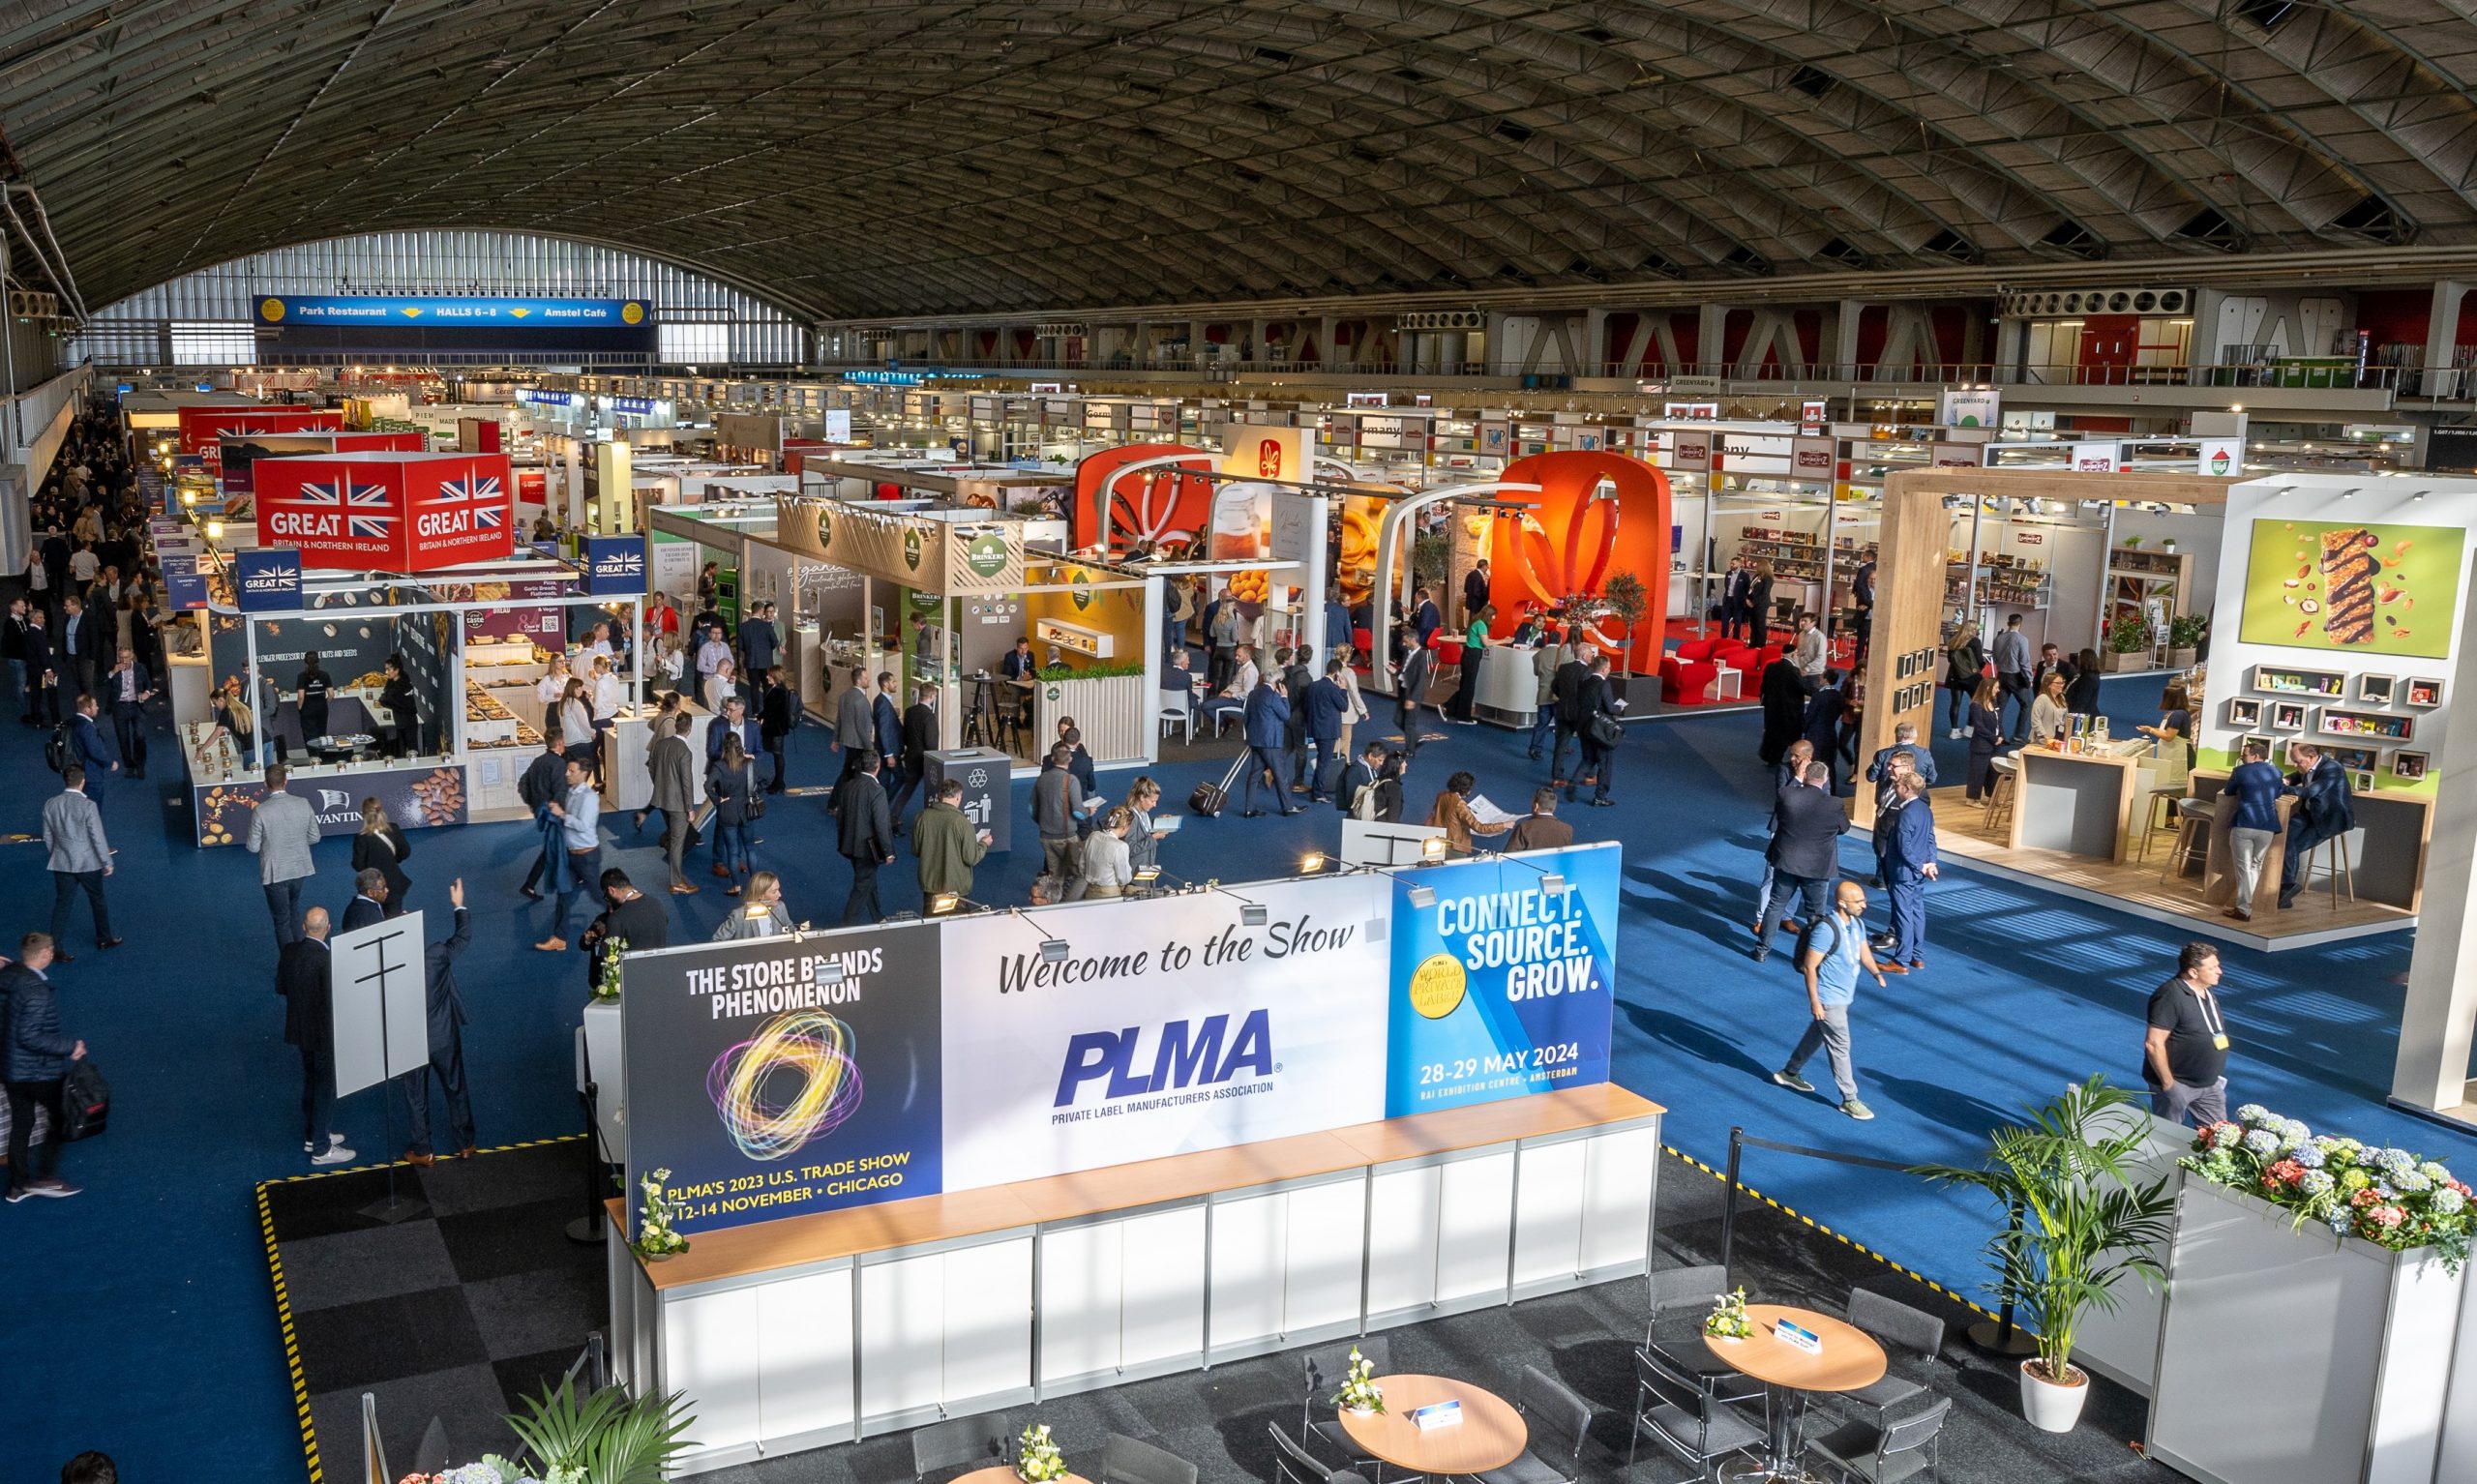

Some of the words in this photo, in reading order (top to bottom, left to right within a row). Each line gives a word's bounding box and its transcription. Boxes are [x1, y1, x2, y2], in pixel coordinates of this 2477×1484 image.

[299, 306, 324, 315] Park
[327, 306, 387, 316] Restaurant
[436, 308, 471, 317] HALLS
[544, 308, 581, 317] Amstel
[582, 308, 607, 317] Café
[1486, 429, 1505, 442] TOP
[1680, 447, 1704, 458] LAMBERTZ
[1800, 454, 1828, 465] LAMBERTZ
[2080, 461, 2108, 472] LAMBERTZ
[270, 512, 341, 537] GREAT
[417, 509, 469, 537] GREAT
[273, 539, 302, 549] BRITAIN
[303, 540, 310, 549] &
[311, 541, 353, 550] NORTHERN
[355, 543, 390, 552] IRELAND
[419, 540, 441, 551] BRITAIN
[442, 540, 447, 549] &
[447, 536, 478, 548] NORTHERN
[479, 531, 502, 543] IRELAND
[245, 579, 277, 588] GREAT
[343, 648, 358, 657] SEEDS
[1437, 883, 1583, 936] CONNECT.
[1000, 950, 1148, 994] Welcome
[1161, 939, 1191, 972] to
[1203, 923, 1253, 965] the
[1263, 914, 1355, 960] Show
[1466, 920, 1589, 971] SOURCE.
[686, 966, 727, 995] THE
[731, 959, 794, 991] STORE
[801, 947, 883, 982] BNDS
[1419, 965, 1462, 981] WORLD
[1507, 955, 1598, 1002] GROW.
[1415, 977, 1463, 994] PRIVATE
[712, 977, 861, 1020] PHENOMENON
[1419, 990, 1460, 1007] LABEL
[1053, 1008, 1273, 1108] PLMA
[1419, 1058, 1477, 1084] 28-29
[1483, 1050, 1529, 1074] MAY
[1533, 1042, 1579, 1067] 2024
[1420, 1090, 1435, 1100] RAI
[1438, 1083, 1486, 1097] EXHIBITION
[1488, 1076, 1520, 1089] CENTRE
[1530, 1066, 1578, 1082] AMSTERDAM
[1052, 1110, 1092, 1126] PRIVATE
[1093, 1104, 1124, 1119] LABEL
[1126, 1090, 1211, 1113] MANUFACTURERS
[1212, 1081, 1273, 1101] ASSOCIATION
[729, 1174, 764, 1193] 2023
[768, 1170, 797, 1187] U.S.
[801, 1159, 855, 1180] TRADE
[859, 1151, 910, 1171] SHOW
[677, 1203, 717, 1221] 12-14
[722, 1186, 813, 1213] NOVEMBER
[826, 1172, 903, 1196] CHICAGO
